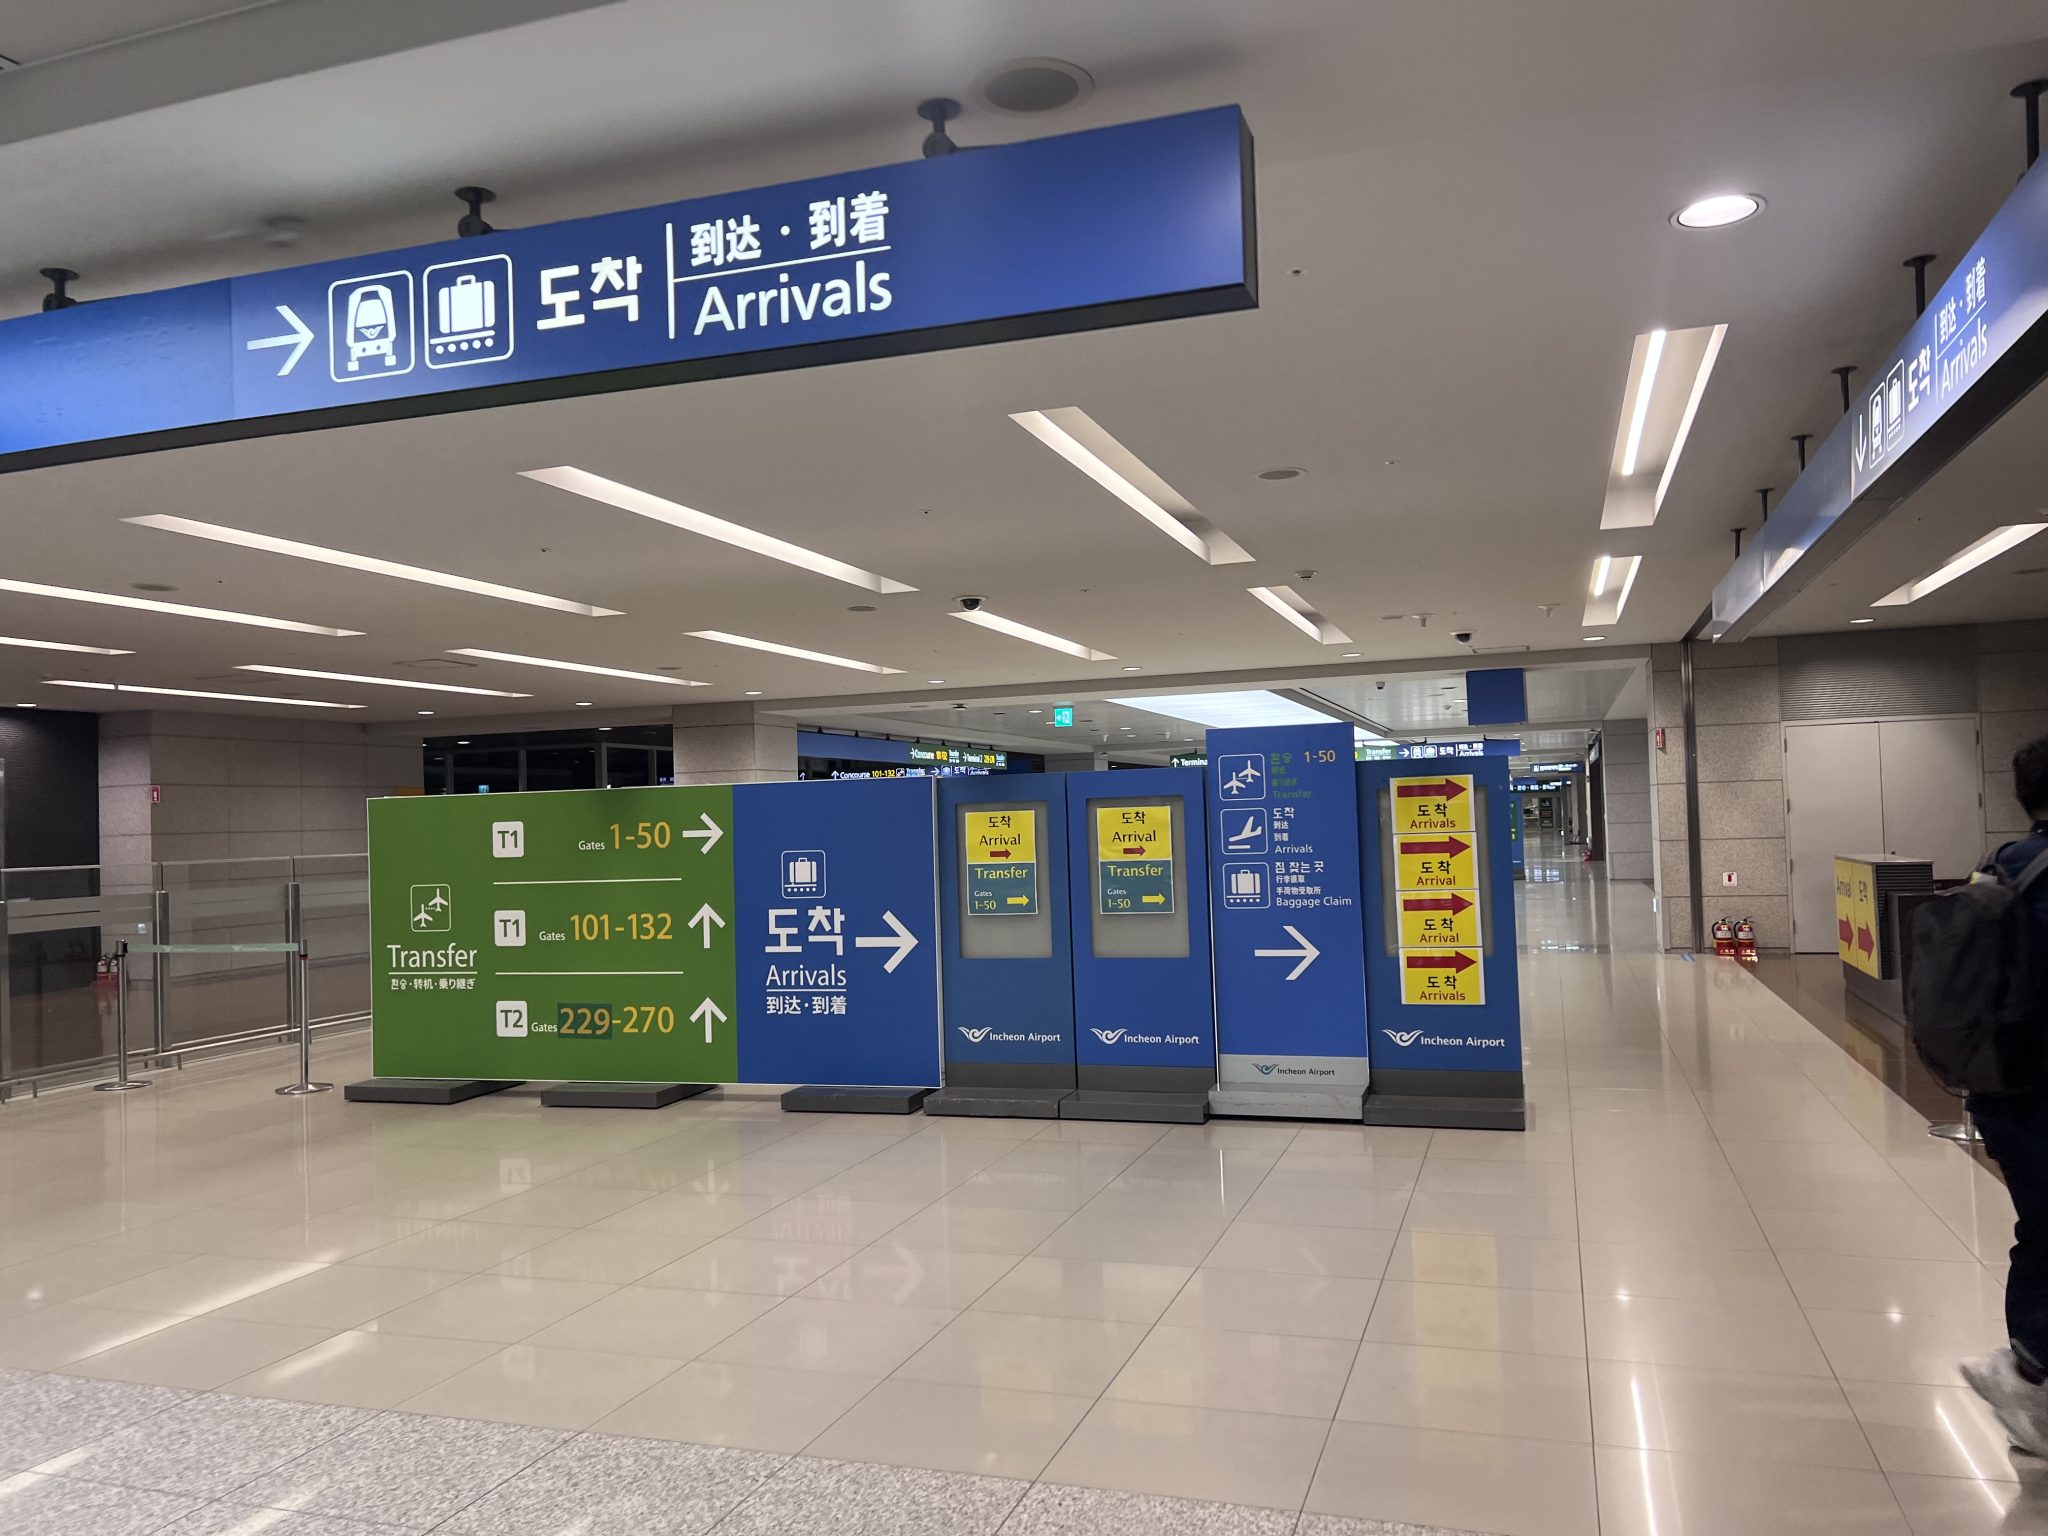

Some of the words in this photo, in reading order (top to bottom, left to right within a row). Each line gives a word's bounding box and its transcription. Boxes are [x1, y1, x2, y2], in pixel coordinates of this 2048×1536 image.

[690, 214, 762, 267] 到达
[808, 190, 889, 250] 到着
[536, 256, 642, 330] 도착
[693, 260, 893, 335] Arrivals
[1941, 316, 1987, 400] Arrivals
[1908, 344, 1931, 412] 도착
[1304, 750, 1336, 763] 1-50
[1439, 746, 1454, 756] 도착
[840, 771, 870, 779] Concourse
[872, 769, 896, 778] 101-132
[1272, 790, 1312, 799] Transfer
[1121, 811, 1146, 825] 도착
[1273, 806, 1295, 819] 도착
[988, 815, 1011, 828] 도착
[1410, 819, 1456, 829] Arrivals
[497, 830, 519, 850] T1
[578, 840, 605, 851] Gates
[609, 821, 672, 850] 1-50
[979, 834, 1021, 846] Arrival
[1112, 830, 1157, 843] Arrival
[1275, 844, 1313, 854] Arrivals
[975, 866, 1028, 879] Transfer
[1107, 864, 1164, 877] Transfer
[1275, 862, 1285, 874] 짐
[1289, 861, 1311, 874] 찾는
[1314, 860, 1324, 873] 곳
[1416, 875, 1456, 886] Arrival
[974, 890, 993, 898] Gates
[1107, 888, 1127, 896] Gates
[1276, 897, 1321, 908] Baggage
[1323, 896, 1352, 906] Claim
[499, 918, 521, 938] T1
[539, 931, 565, 942] Gates
[570, 912, 673, 941] 101-132
[765, 905, 845, 956] 도착
[1419, 933, 1459, 944] Arrival
[387, 943, 478, 969] Transfer
[766, 963, 847, 987] Arrivals
[1419, 991, 1466, 1001] Arrivals
[500, 1009, 524, 1029] T2
[531, 1022, 558, 1033] Gates
[559, 1006, 675, 1036] 229-270
[989, 1032, 1025, 1042] Incheon
[1028, 1032, 1061, 1044] Airport
[1124, 1034, 1161, 1044] Incheon
[1165, 1035, 1200, 1046] Airport
[1421, 1036, 1462, 1046] Incheon
[1466, 1036, 1505, 1048] Airport
[1277, 1068, 1306, 1076] Incheon
[1308, 1068, 1335, 1077] Airport
